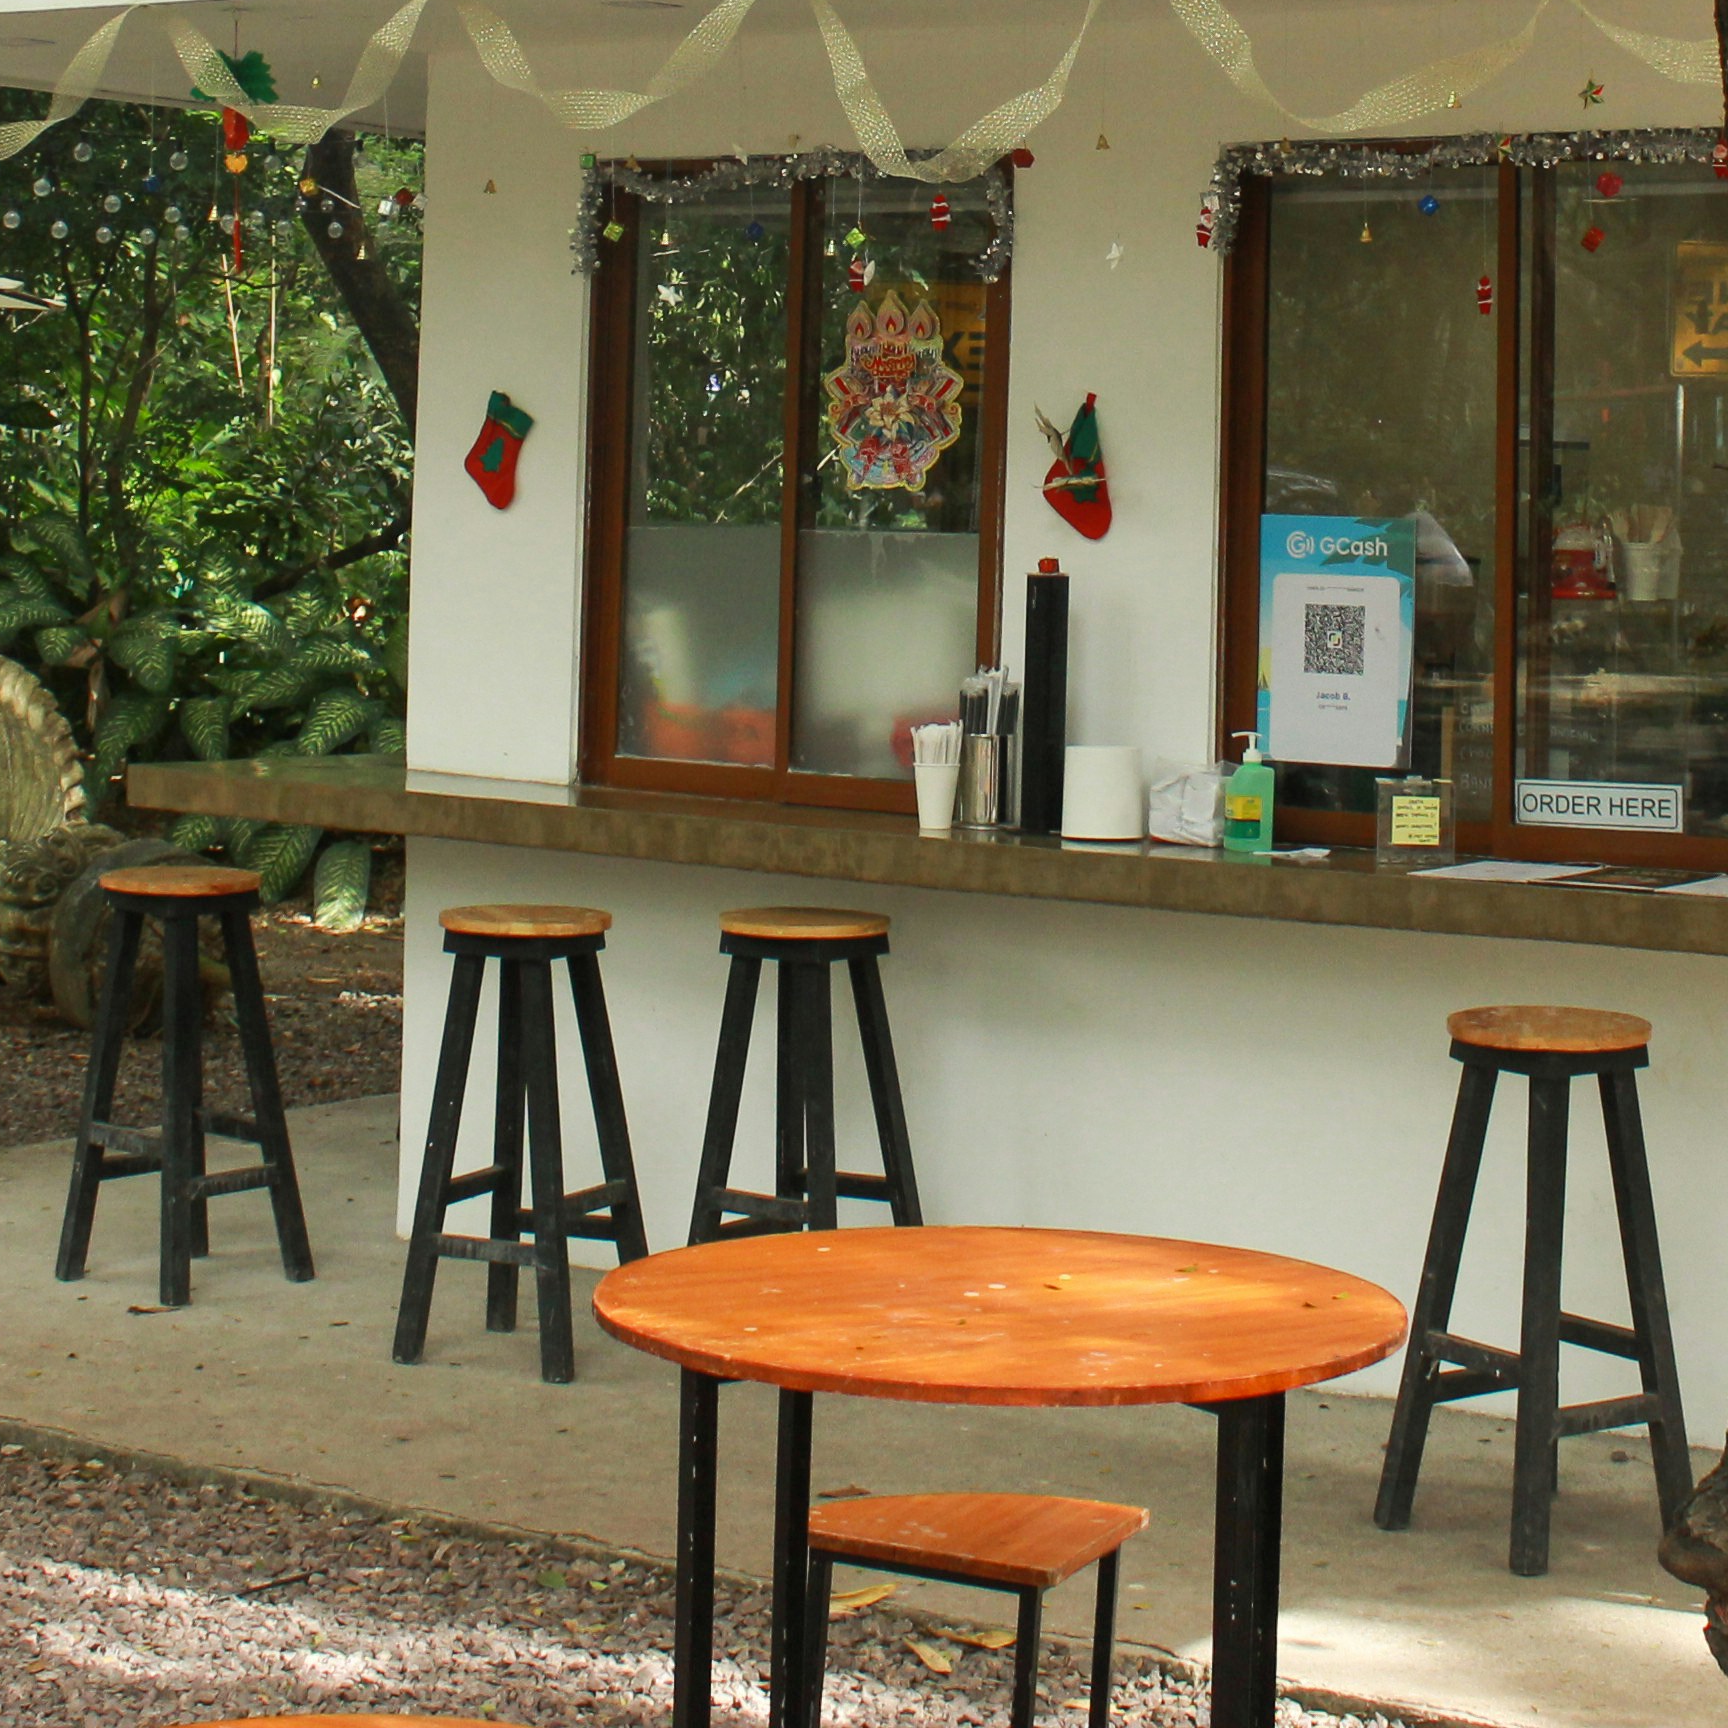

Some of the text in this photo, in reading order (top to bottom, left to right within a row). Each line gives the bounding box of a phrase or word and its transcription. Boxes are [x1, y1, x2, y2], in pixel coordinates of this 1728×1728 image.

[1320, 536, 1388, 557] GCash
[1316, 691, 1340, 700] Jacob
[1522, 793, 1672, 820] ORDER HERE
